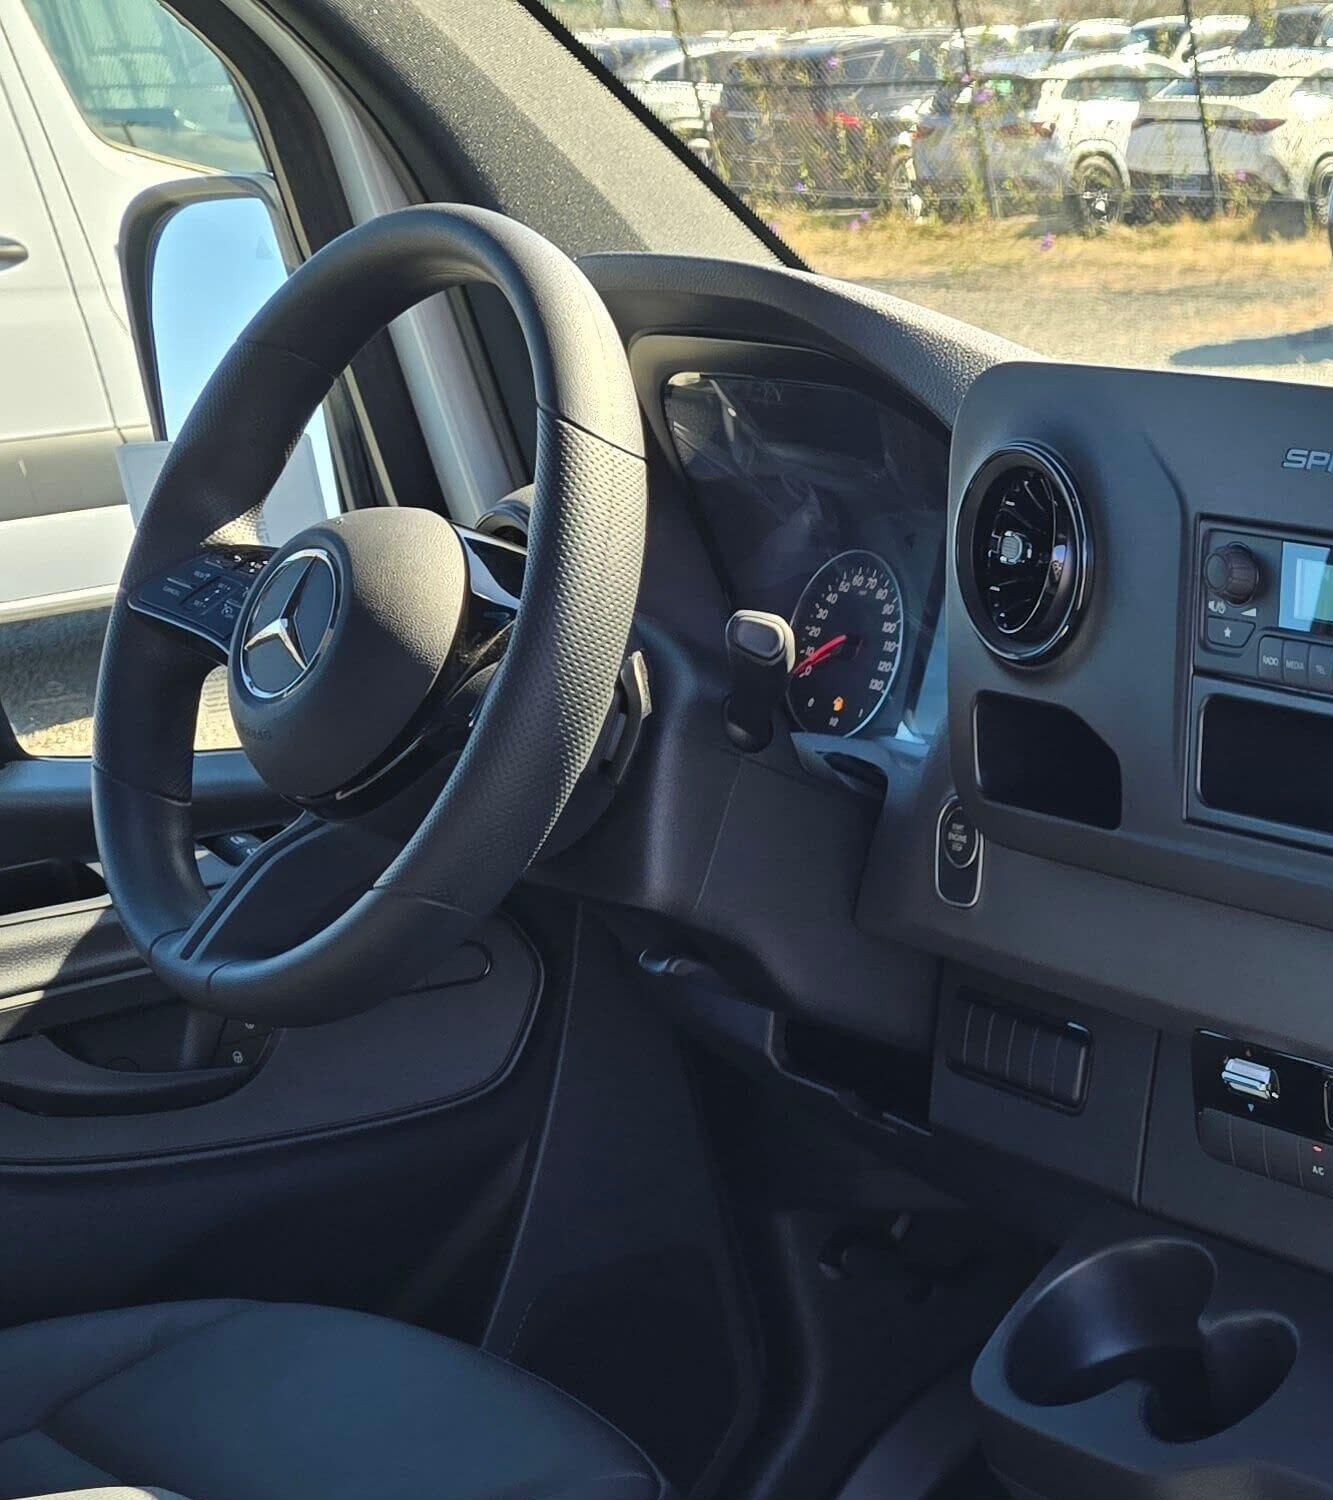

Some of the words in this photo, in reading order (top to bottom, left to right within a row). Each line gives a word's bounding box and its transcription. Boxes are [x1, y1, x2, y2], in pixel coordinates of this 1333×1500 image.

[852, 574, 864, 586] 60
[865, 577, 878, 589] 70
[838, 581, 850, 592] 50
[826, 593, 838, 604] 40
[816, 607, 828, 620] 30
[809, 625, 821, 637] 20
[882, 621, 897, 634] 100
[883, 641, 896, 652] 110
[1263, 655, 1279, 666] RADIO
[877, 661, 892, 672] 120
